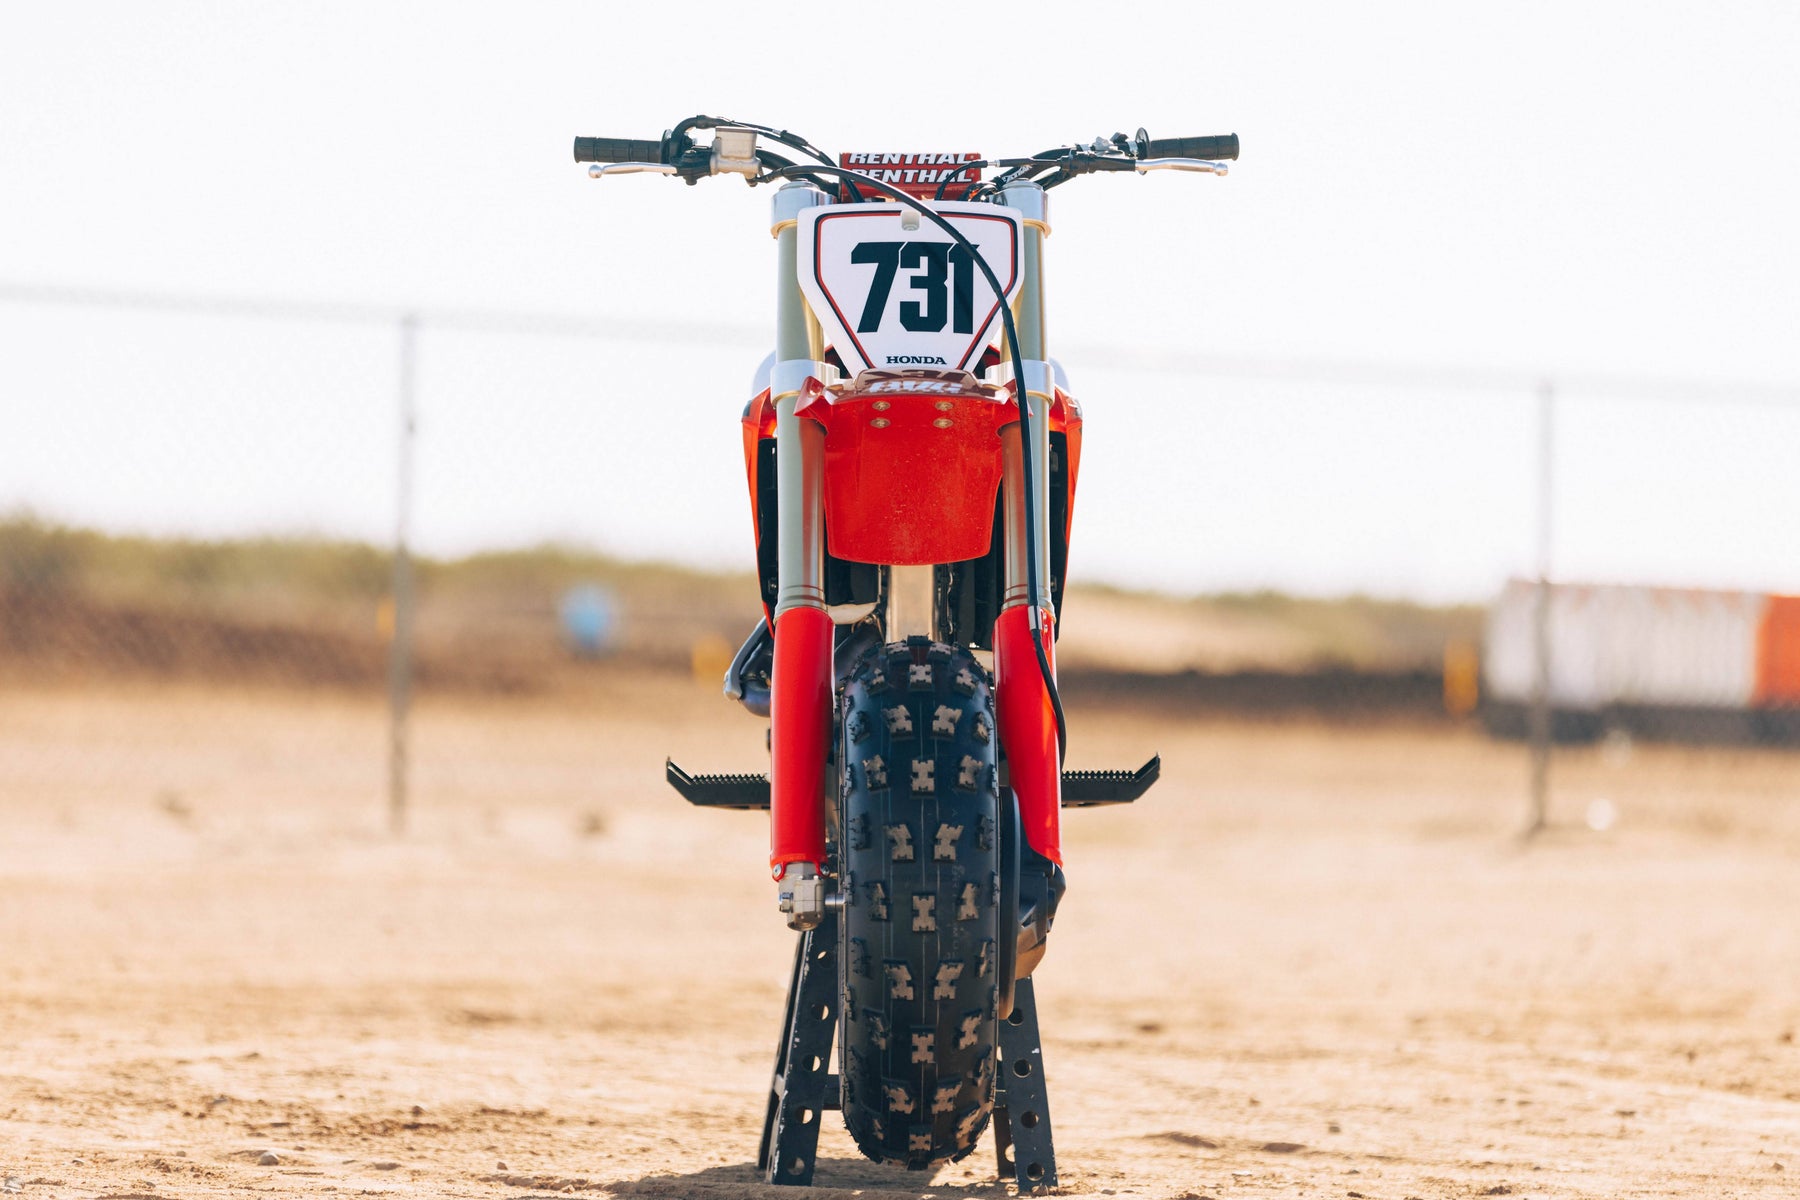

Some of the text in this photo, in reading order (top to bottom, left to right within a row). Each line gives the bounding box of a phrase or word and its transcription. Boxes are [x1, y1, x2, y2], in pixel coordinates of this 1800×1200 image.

[848, 153, 973, 165] RENTHAL
[851, 241, 980, 334] 731
[886, 355, 947, 365] HONDA
